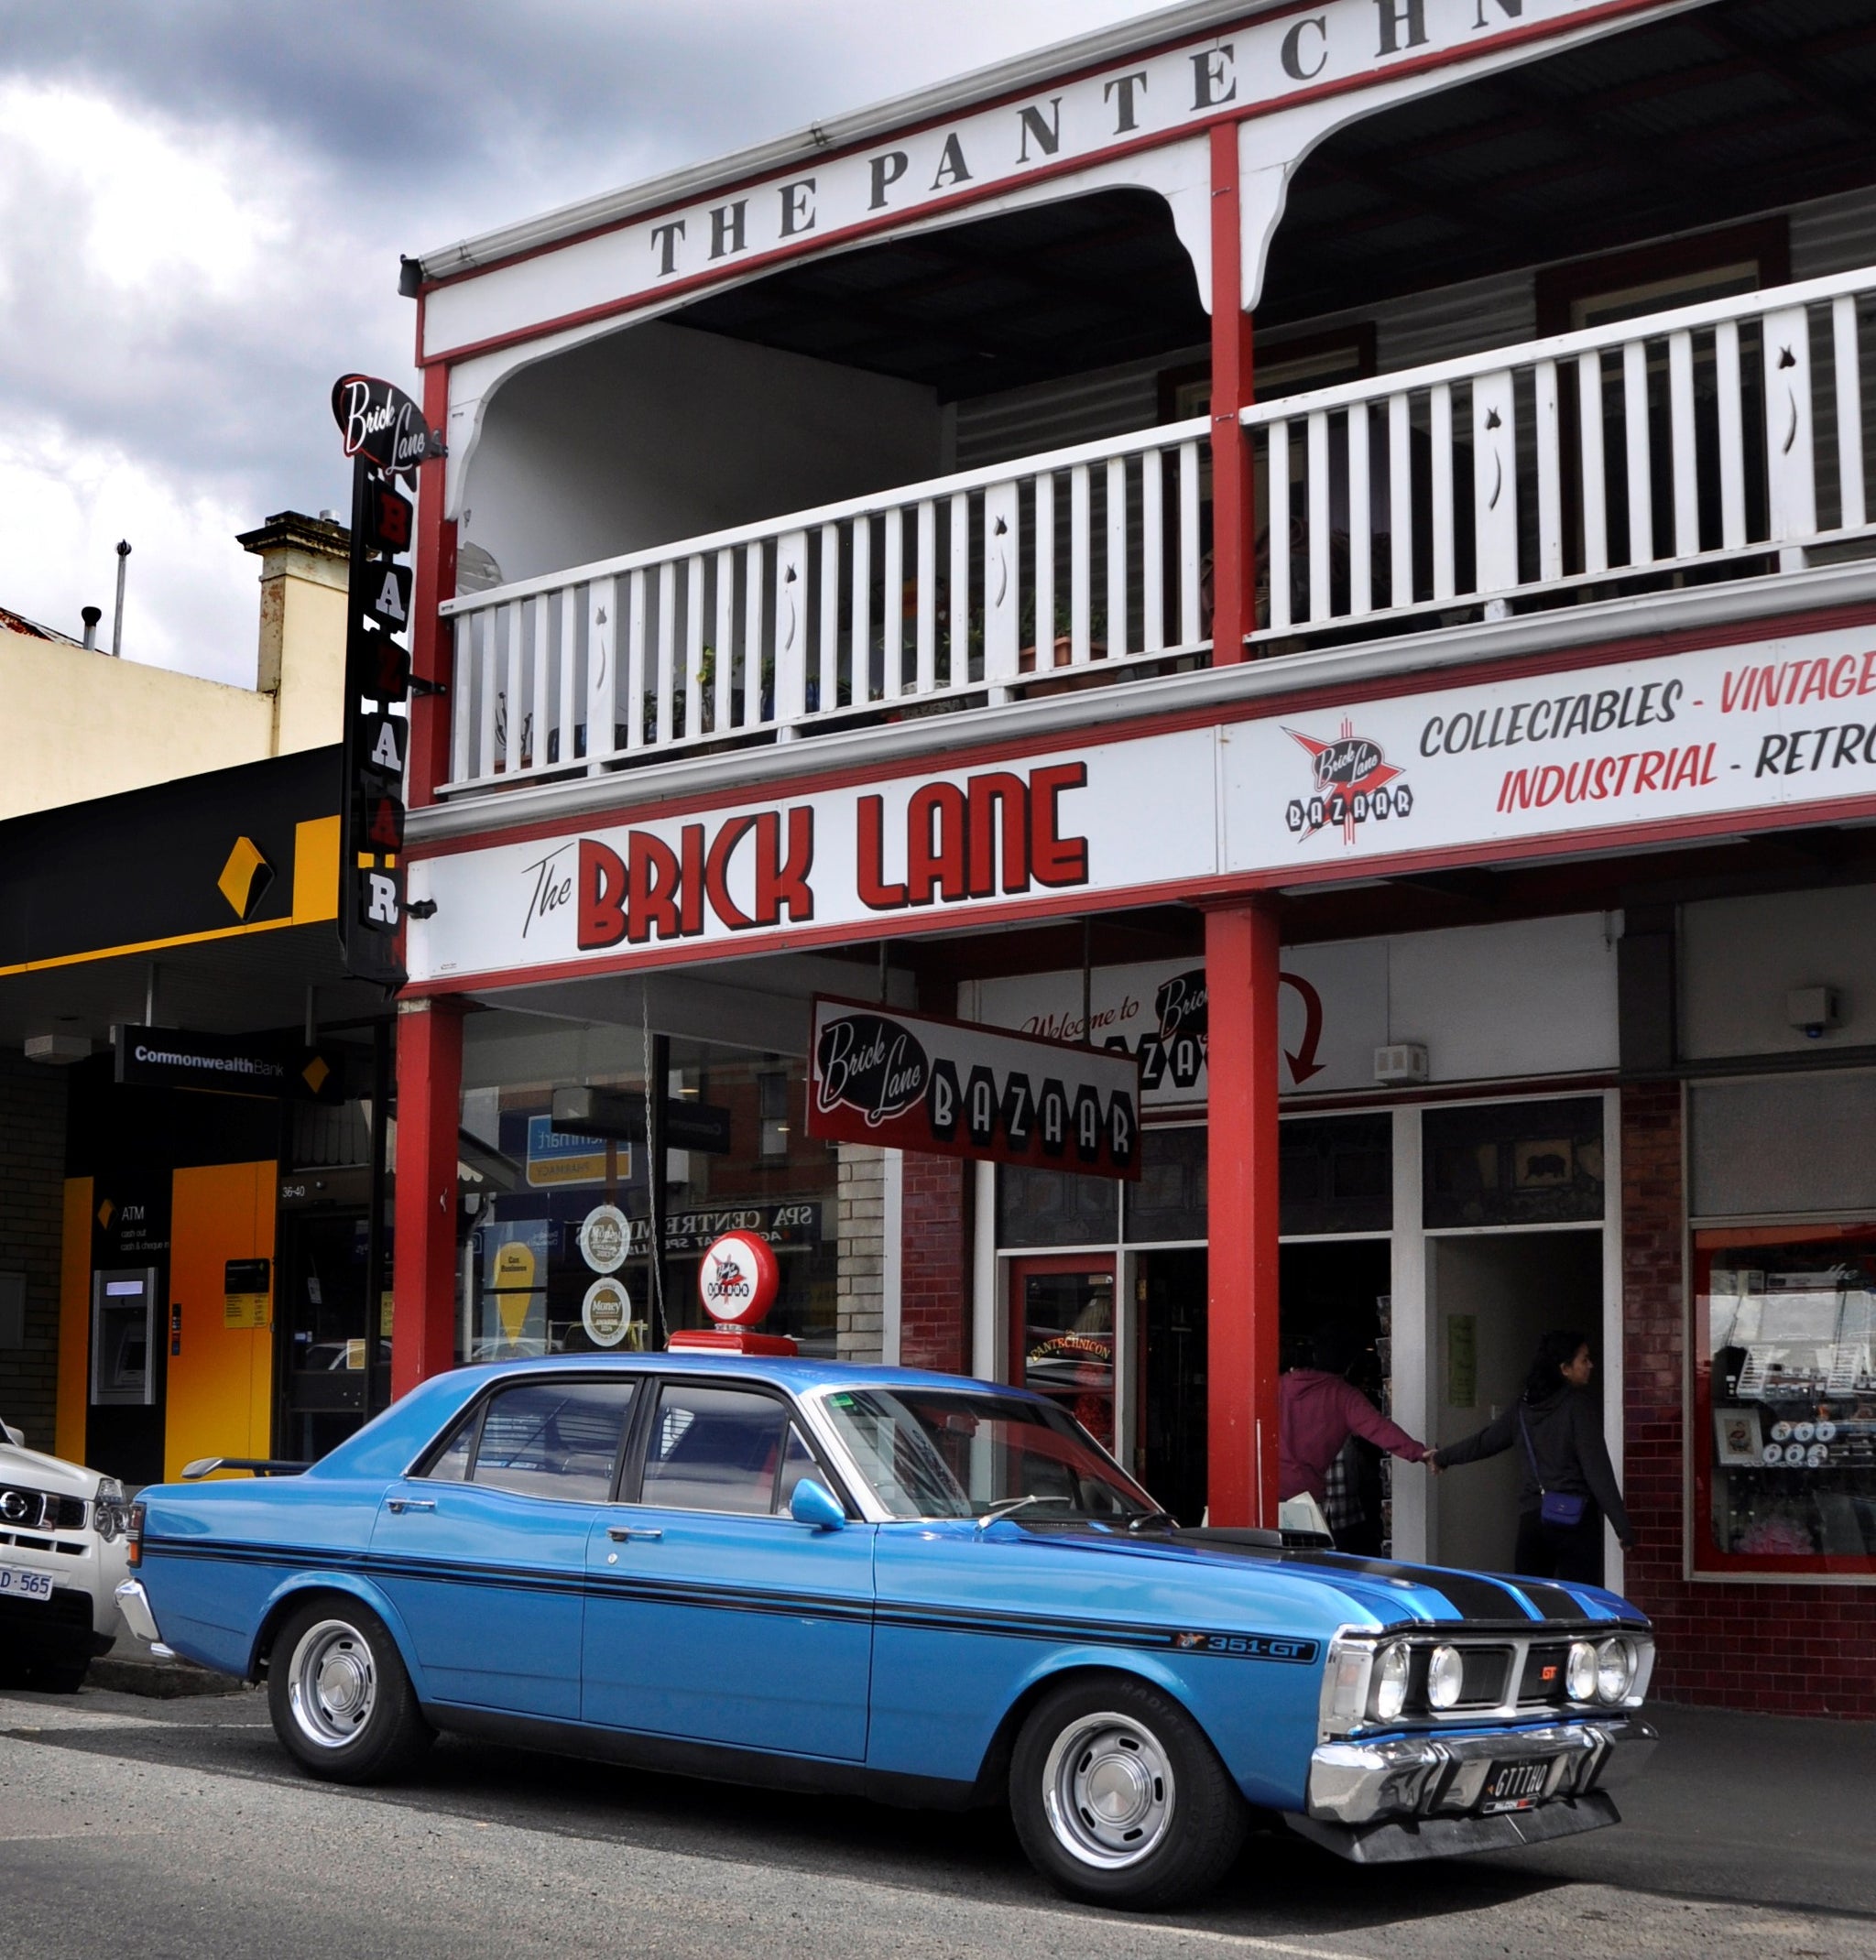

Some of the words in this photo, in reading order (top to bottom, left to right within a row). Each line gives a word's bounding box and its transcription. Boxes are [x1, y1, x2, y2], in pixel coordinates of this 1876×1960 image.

[651, 178, 817, 278] THE
[344, 381, 396, 454] Brick
[386, 403, 426, 475] Lane
[1420, 680, 1683, 757] COLLECTABLES
[1315, 746, 1355, 788] Brick
[1347, 744, 1379, 788] Lane
[1496, 743, 1718, 813] INDUSTRIAL
[1289, 788, 1410, 825] BAZAAR
[520, 842, 576, 939] The
[577, 805, 814, 951] BRICK
[856, 761, 1089, 911] LANE
[1020, 1008, 1116, 1040] Welcome
[1120, 996, 1139, 1021] to
[1161, 977, 1207, 1039] Bric
[823, 1022, 886, 1102] Brick
[871, 1034, 921, 1117] Lane
[935, 1080, 1129, 1154] BAZAAR
[121, 1205, 145, 1221] ATM
[592, 1300, 621, 1314] Money
[1541, 1665, 1556, 1680] GT
